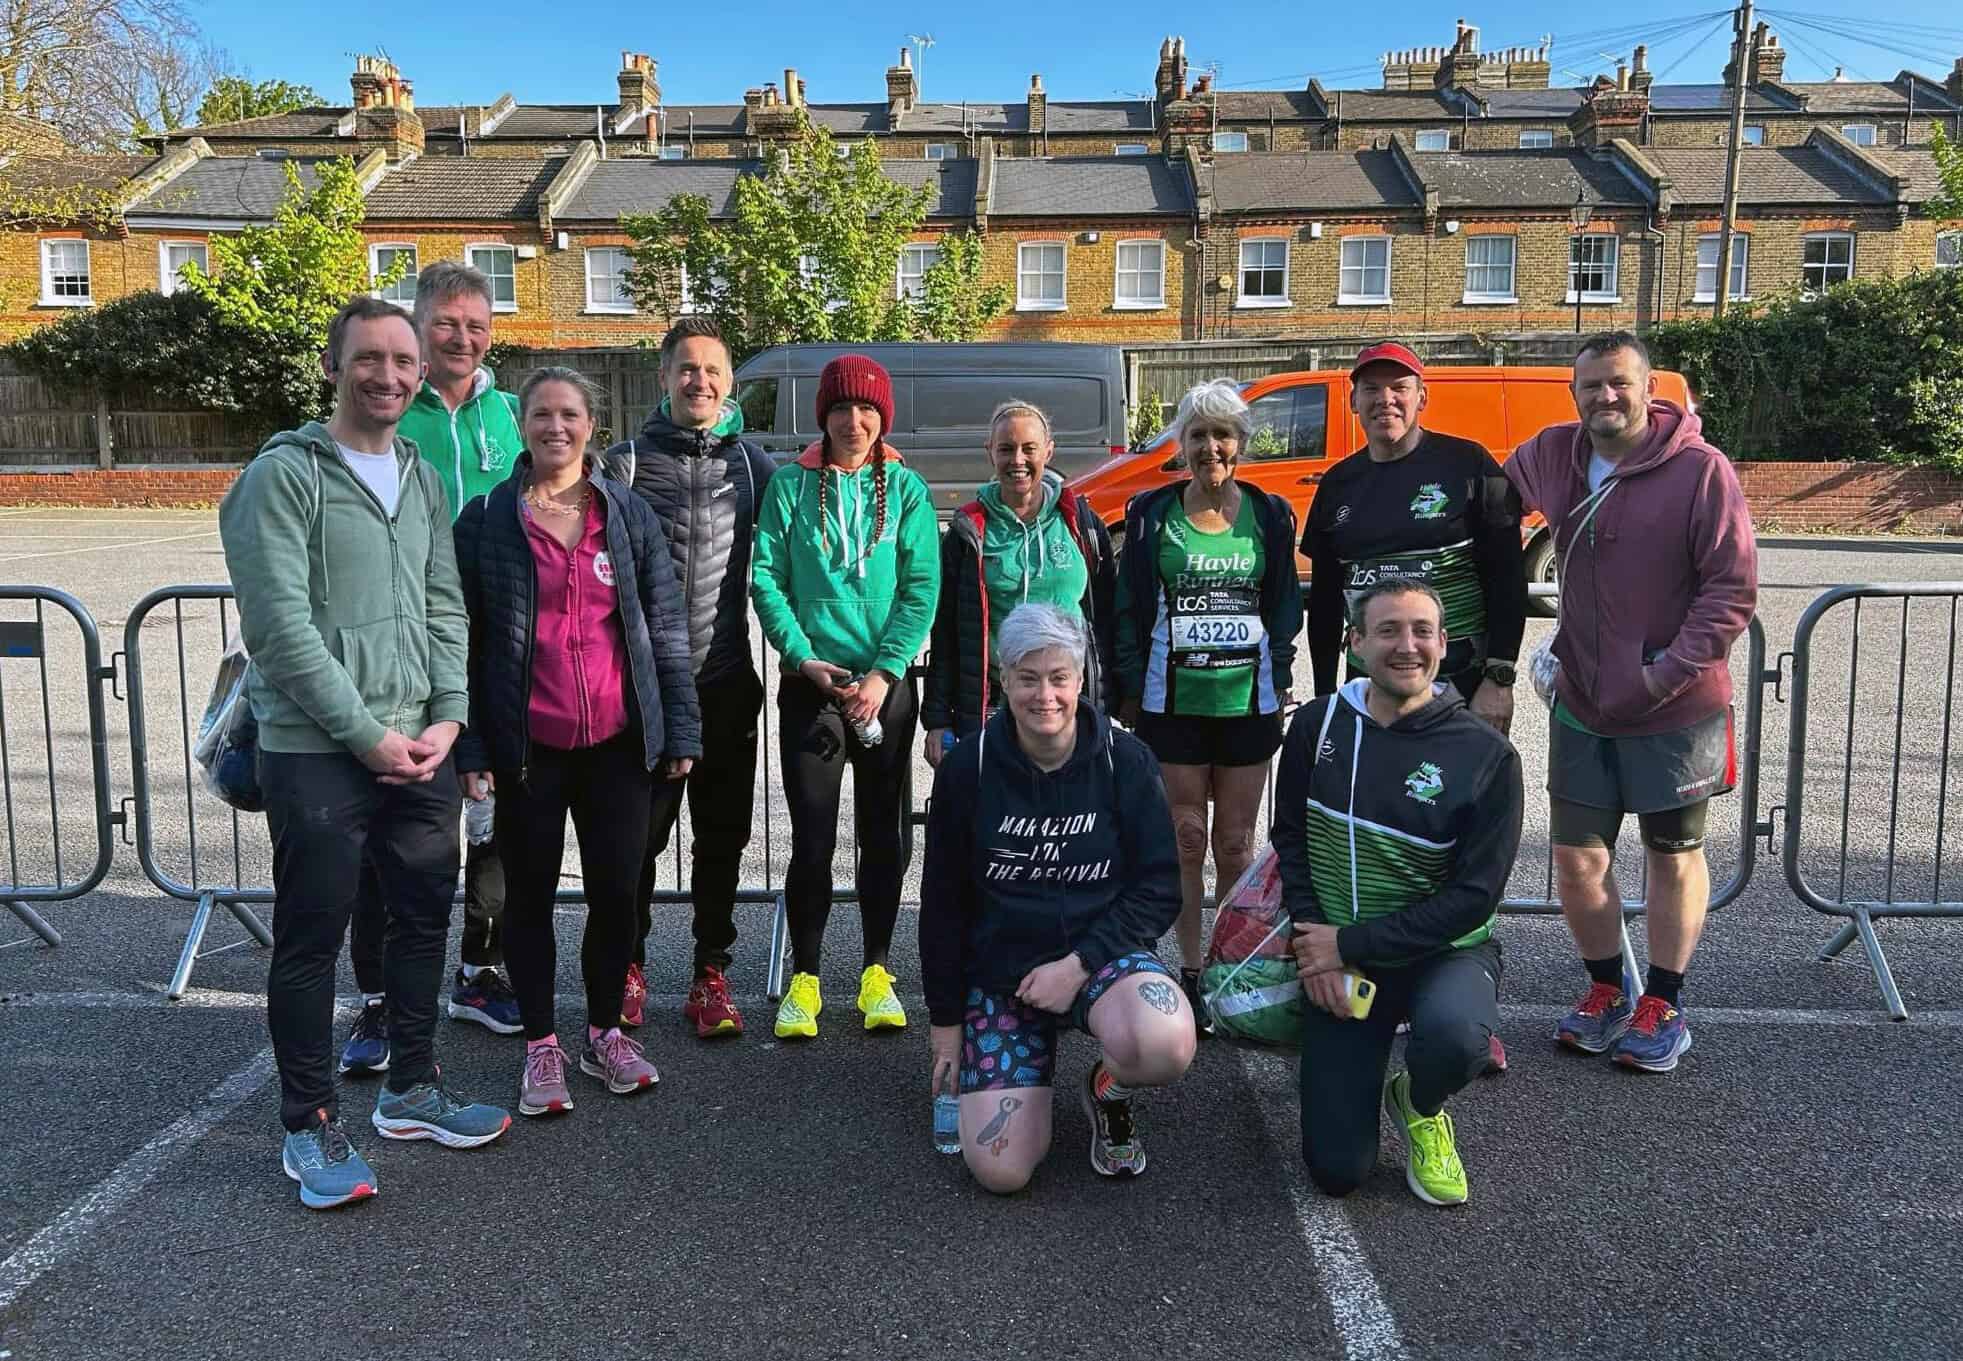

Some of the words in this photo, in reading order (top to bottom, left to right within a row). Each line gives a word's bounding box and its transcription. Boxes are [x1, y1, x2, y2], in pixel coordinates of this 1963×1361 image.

[1184, 553, 1251, 575] Hayle
[1186, 622, 1249, 643] 43220
[985, 861, 1024, 881] THE
[1029, 858, 1111, 882] REVIVAL
